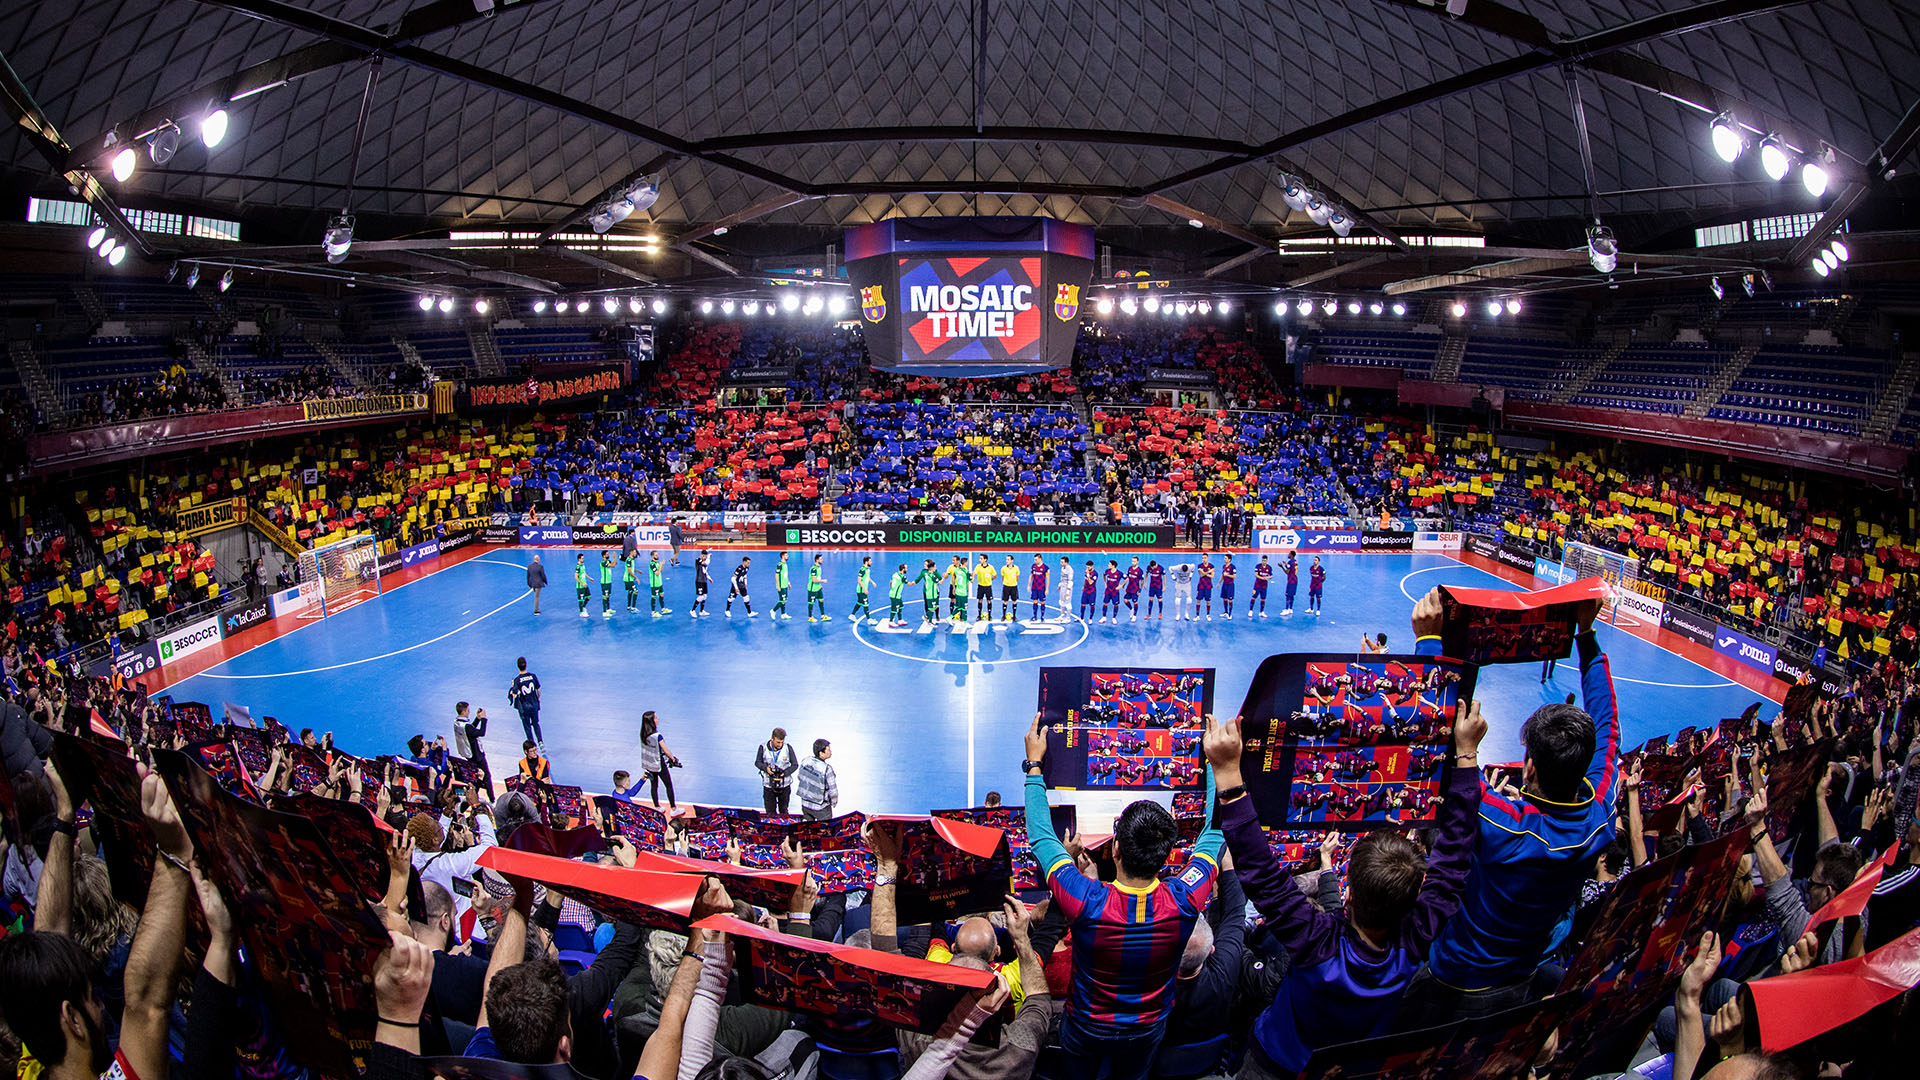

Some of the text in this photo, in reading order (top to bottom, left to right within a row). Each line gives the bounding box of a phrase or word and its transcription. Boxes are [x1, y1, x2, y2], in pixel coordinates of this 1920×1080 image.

[910, 285, 1032, 312] MOSAIC
[927, 312, 1014, 338] TIME!
[306, 395, 401, 418] INCONDICIONALS
[178, 504, 232, 531] CORBA SUD
[802, 530, 1156, 544] BESOCCER DISPONIBLE PARA IPHONE Y ANDROID
[1440, 534, 1458, 542] SEUR
[1624, 596, 1660, 618] BESOCCER
[174, 625, 218, 651] BESOCCER
[1268, 718, 1278, 735] SENT
[1266, 736, 1275, 744] EL
